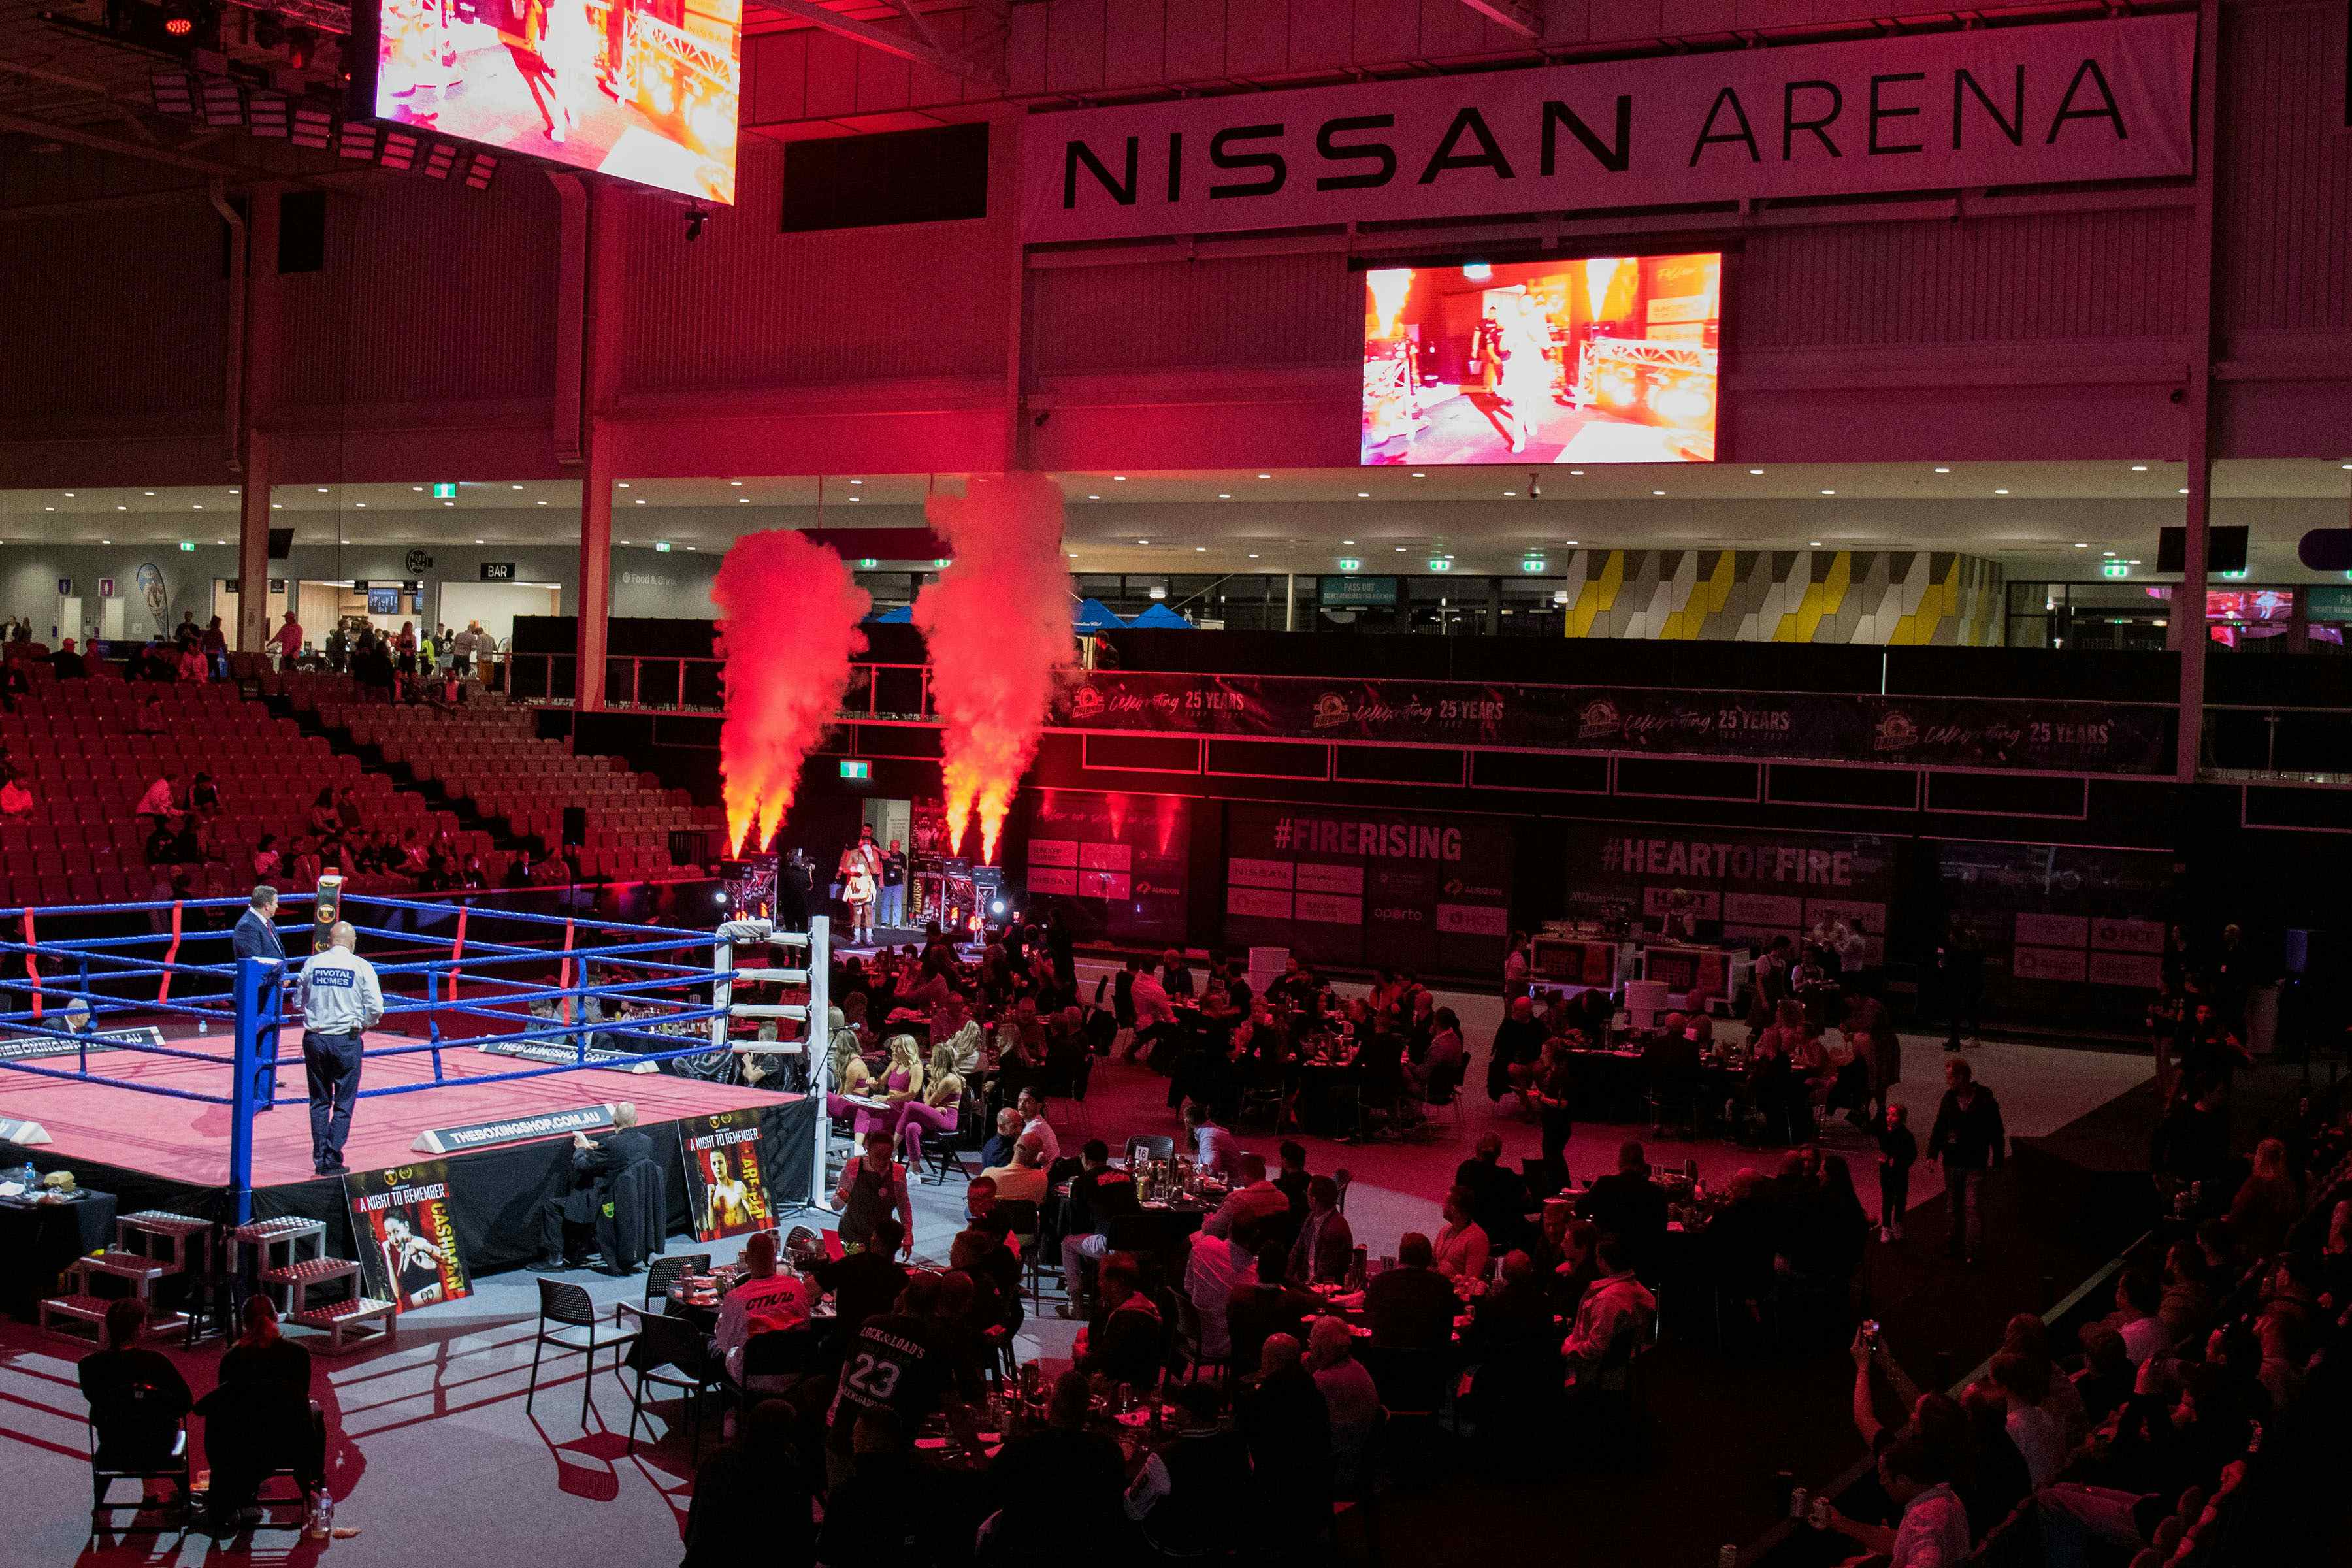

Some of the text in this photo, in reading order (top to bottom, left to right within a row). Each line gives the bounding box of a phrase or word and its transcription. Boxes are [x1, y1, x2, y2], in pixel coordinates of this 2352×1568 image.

[1063, 59, 2129, 210] NISSAN ARENA
[488, 565, 507, 578] BAR
[632, 574, 649, 585] Food
[651, 575, 657, 585] &
[1344, 583, 1375, 591] PASS OUT
[2340, 595, 2352, 604] PA
[1185, 691, 1202, 709] 25
[1207, 691, 1244, 710] YEARS
[1439, 700, 1457, 719] 25
[1462, 700, 1504, 721] YEARS
[1719, 710, 1737, 729] 25
[1741, 711, 1789, 731] YEARS
[2030, 721, 2051, 743] 25
[2056, 723, 2108, 744] YEARS
[1274, 817, 1462, 861] #FIRERISING
[1601, 838, 1853, 886] #HEARTOFFIRE
[1235, 868, 1287, 879] NISSAN
[1152, 887, 1181, 896] AURIZON
[1465, 886, 1503, 896] AURIZON
[1653, 892, 1710, 907] HRT
[1374, 908, 1422, 921] oporto
[1812, 909, 1876, 922] NSSAN
[314, 969, 352, 979] PIVOTAL
[316, 977, 349, 986] HOMES
[449, 1111, 600, 1144] THEBOXINGSHOP.COM.AU
[690, 1128, 759, 1151] A NIGHT TO REMEMBER
[1138, 1149, 1147, 1159] 16
[360, 1183, 446, 1212] A NIGHT TO REMEMBER
[431, 1202, 465, 1292] CASHMAN
[849, 1350, 901, 1397] 23
